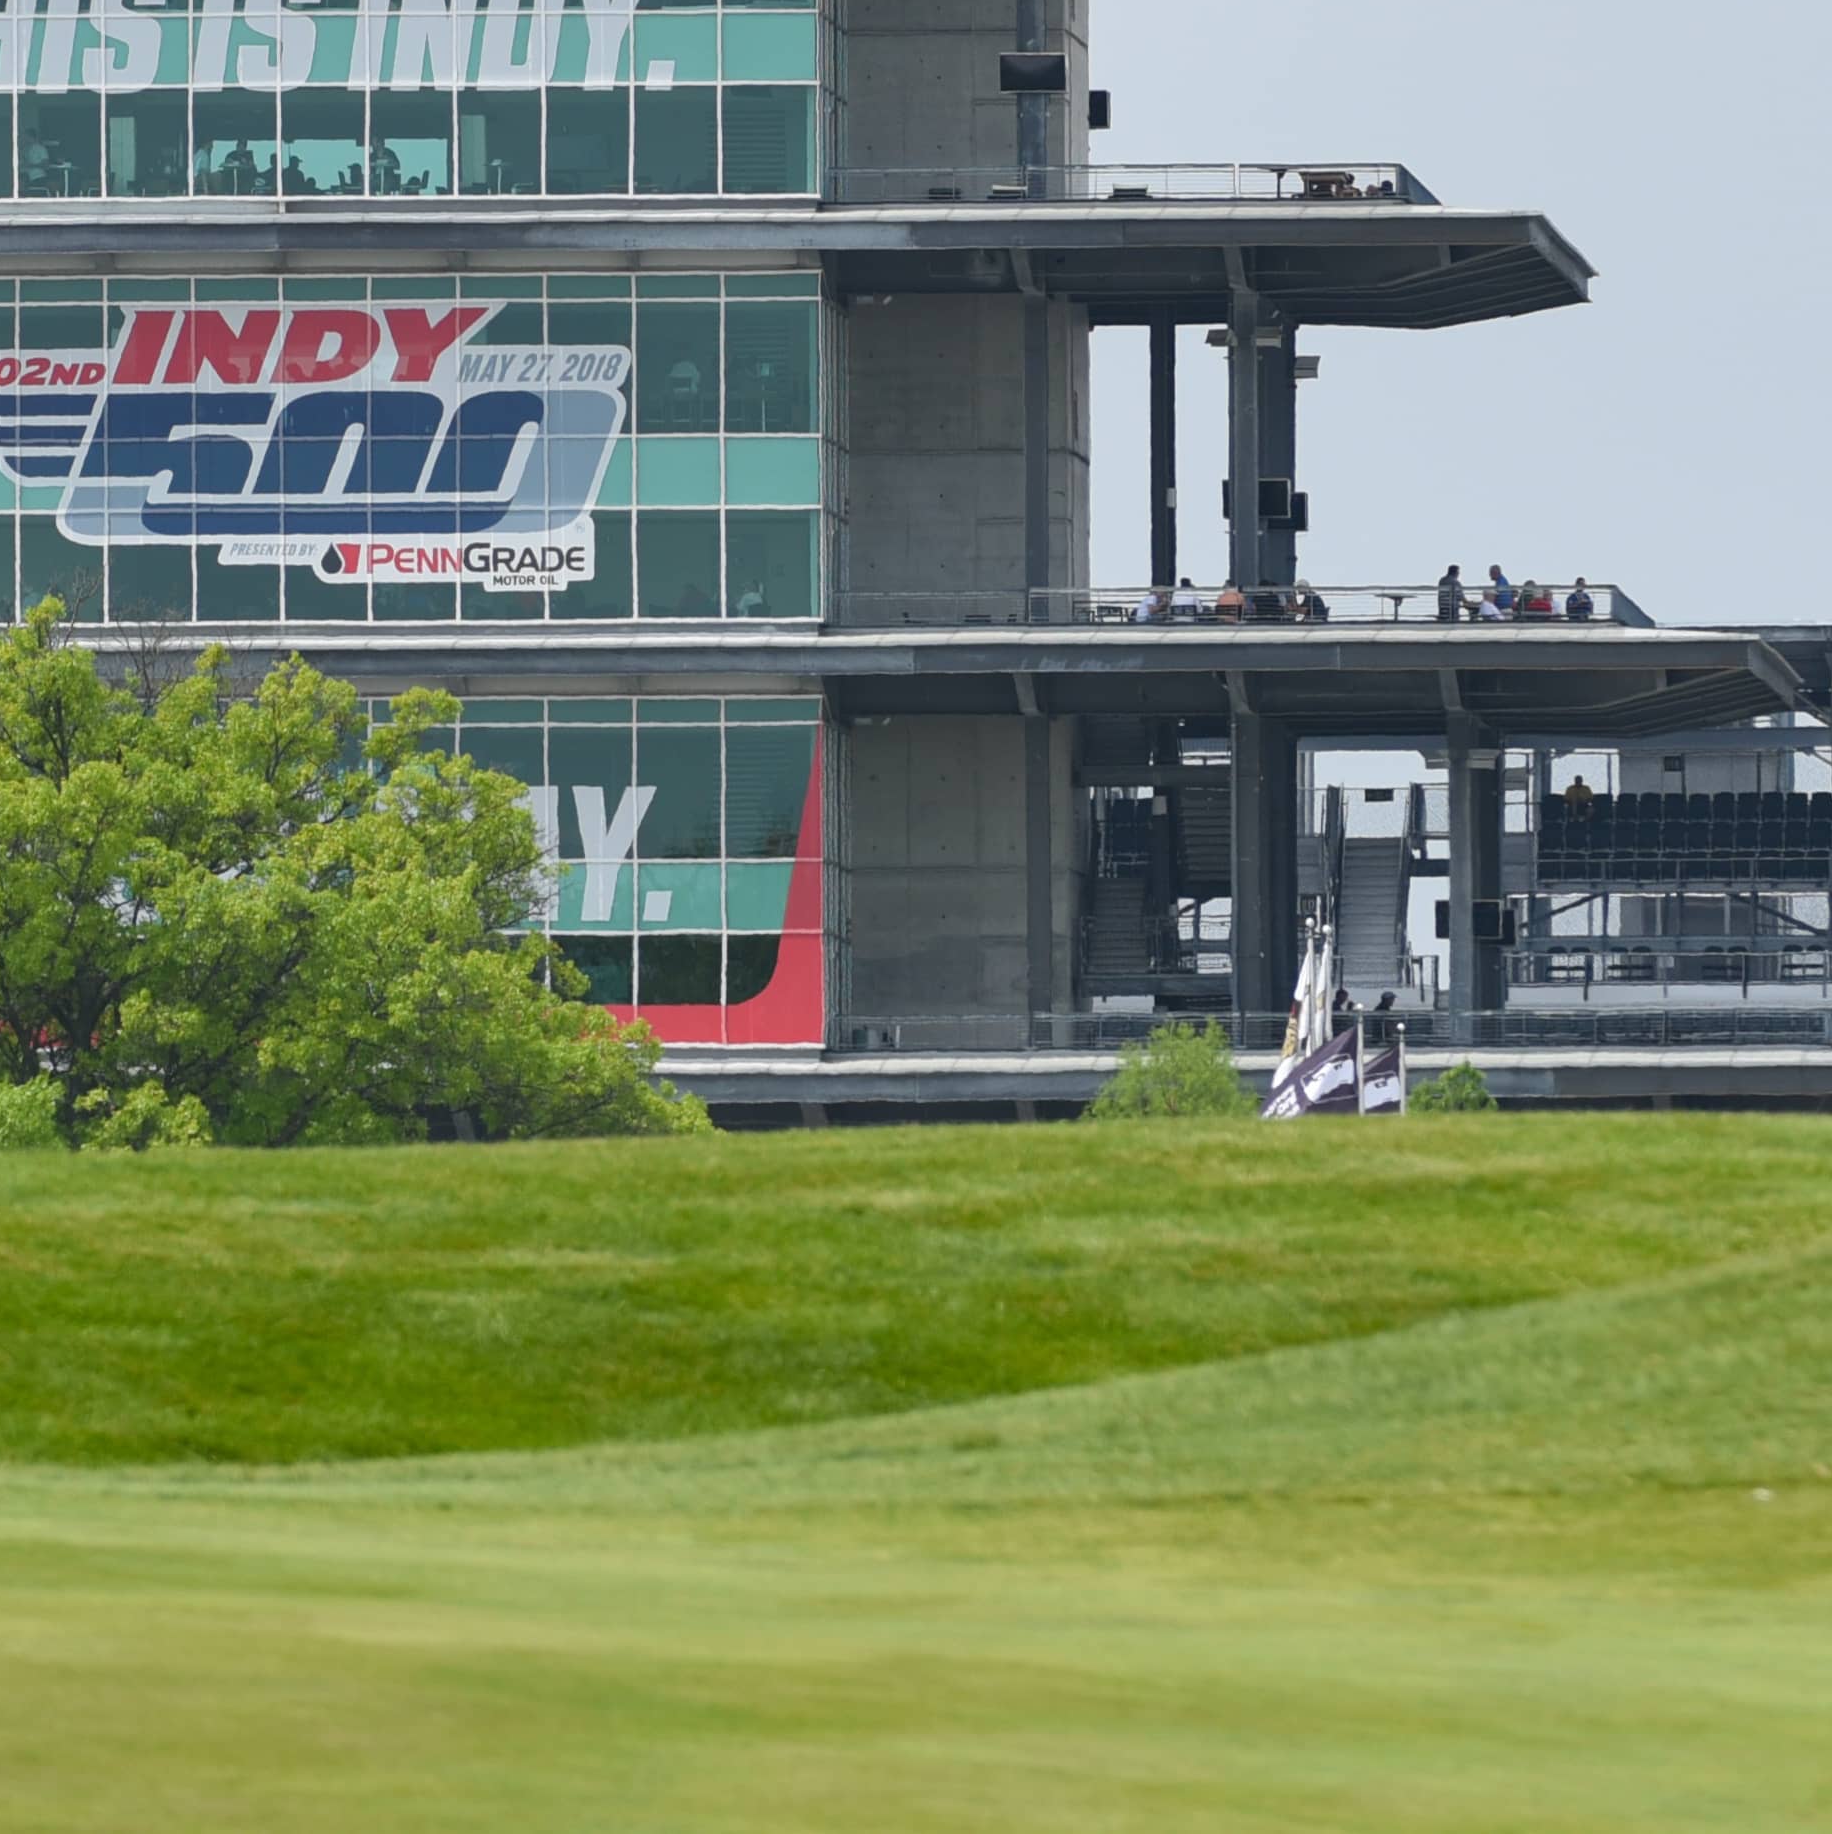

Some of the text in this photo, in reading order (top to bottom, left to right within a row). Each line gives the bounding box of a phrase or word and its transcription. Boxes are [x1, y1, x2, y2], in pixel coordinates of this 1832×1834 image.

[112, 307, 491, 384] INDY
[458, 353, 517, 383] MAY
[559, 352, 623, 383] 2018
[77, 390, 545, 535] 500
[229, 542, 297, 558] PRESENTED
[492, 574, 559, 586] MOTOR OIL
